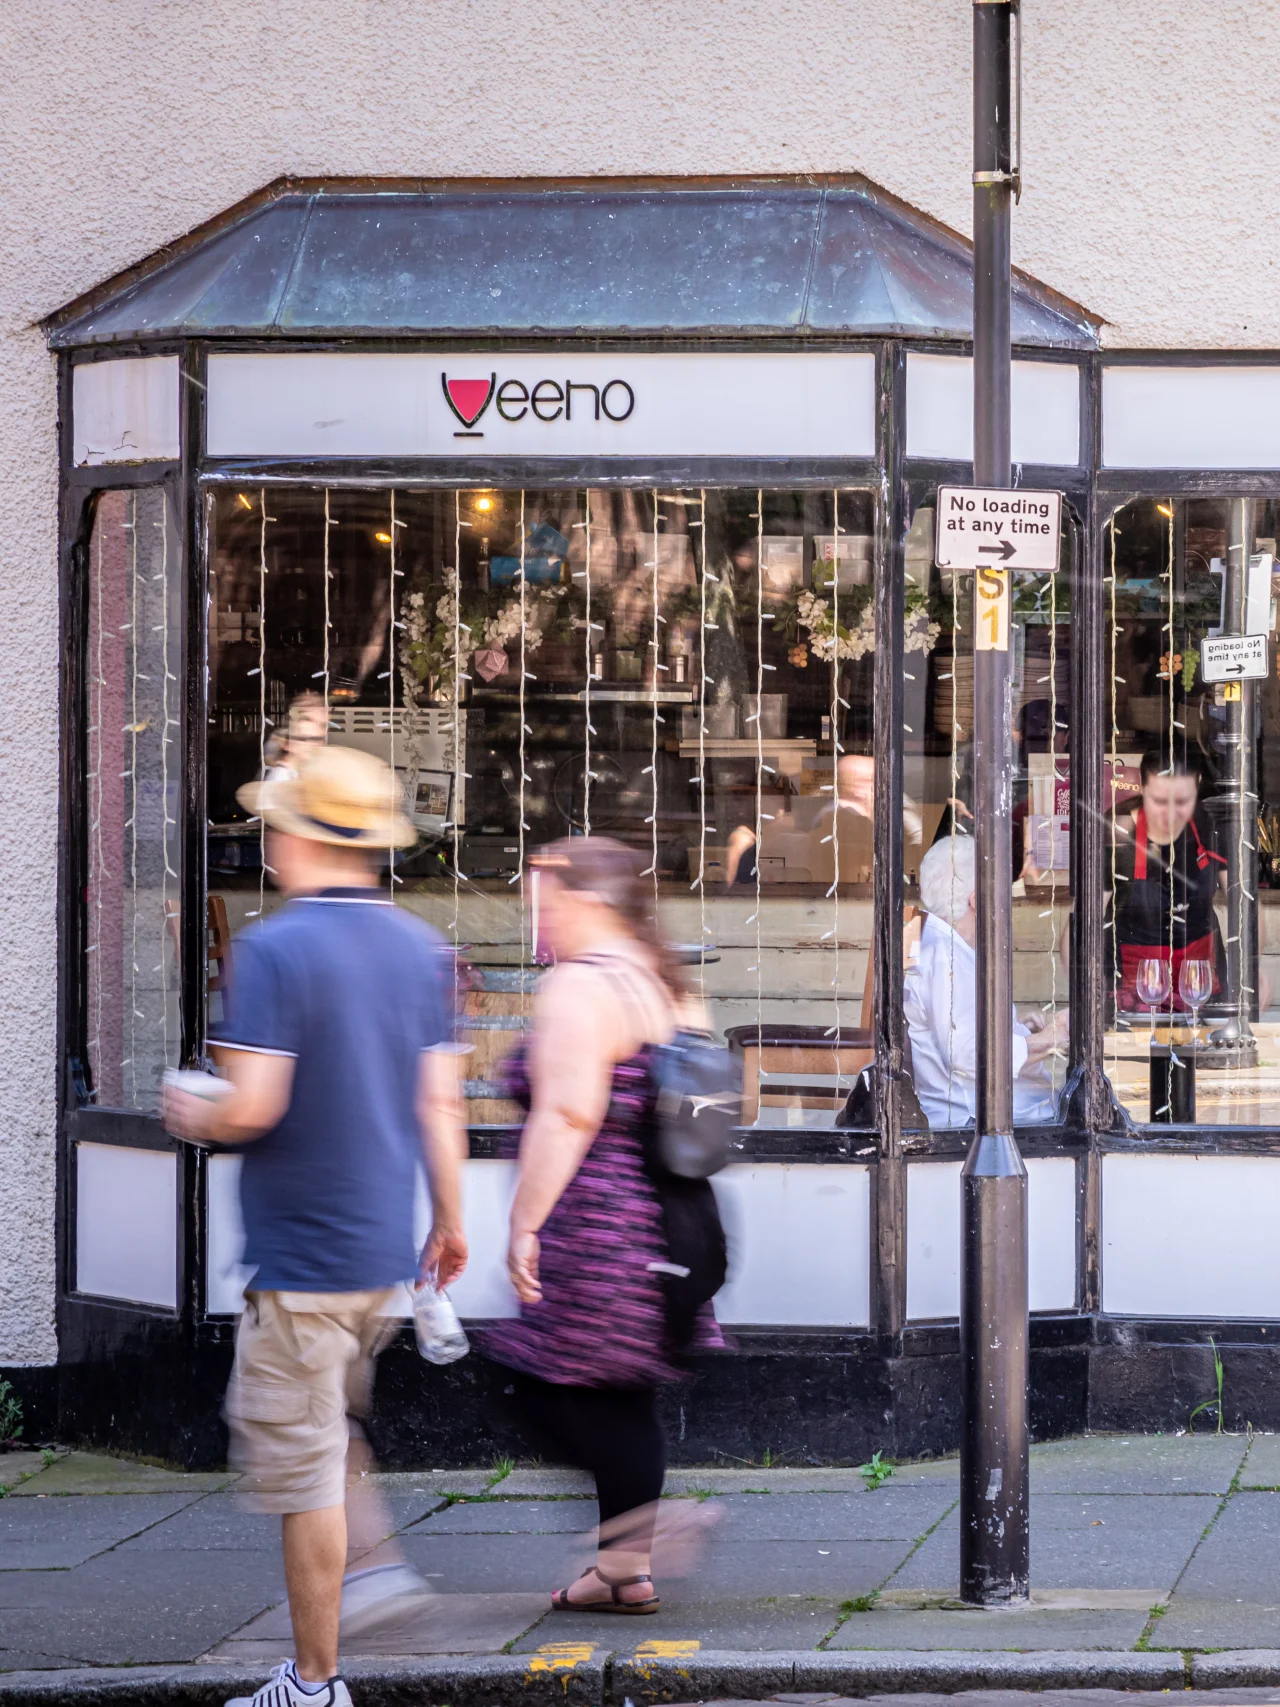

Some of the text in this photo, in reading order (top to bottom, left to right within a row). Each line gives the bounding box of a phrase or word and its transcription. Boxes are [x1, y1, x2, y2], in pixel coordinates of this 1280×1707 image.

[441, 372, 635, 437] Veeno
[950, 496, 1049, 518] No loading
[947, 517, 1051, 535] at any time
[978, 568, 1005, 600] S
[982, 605, 999, 643] 1
